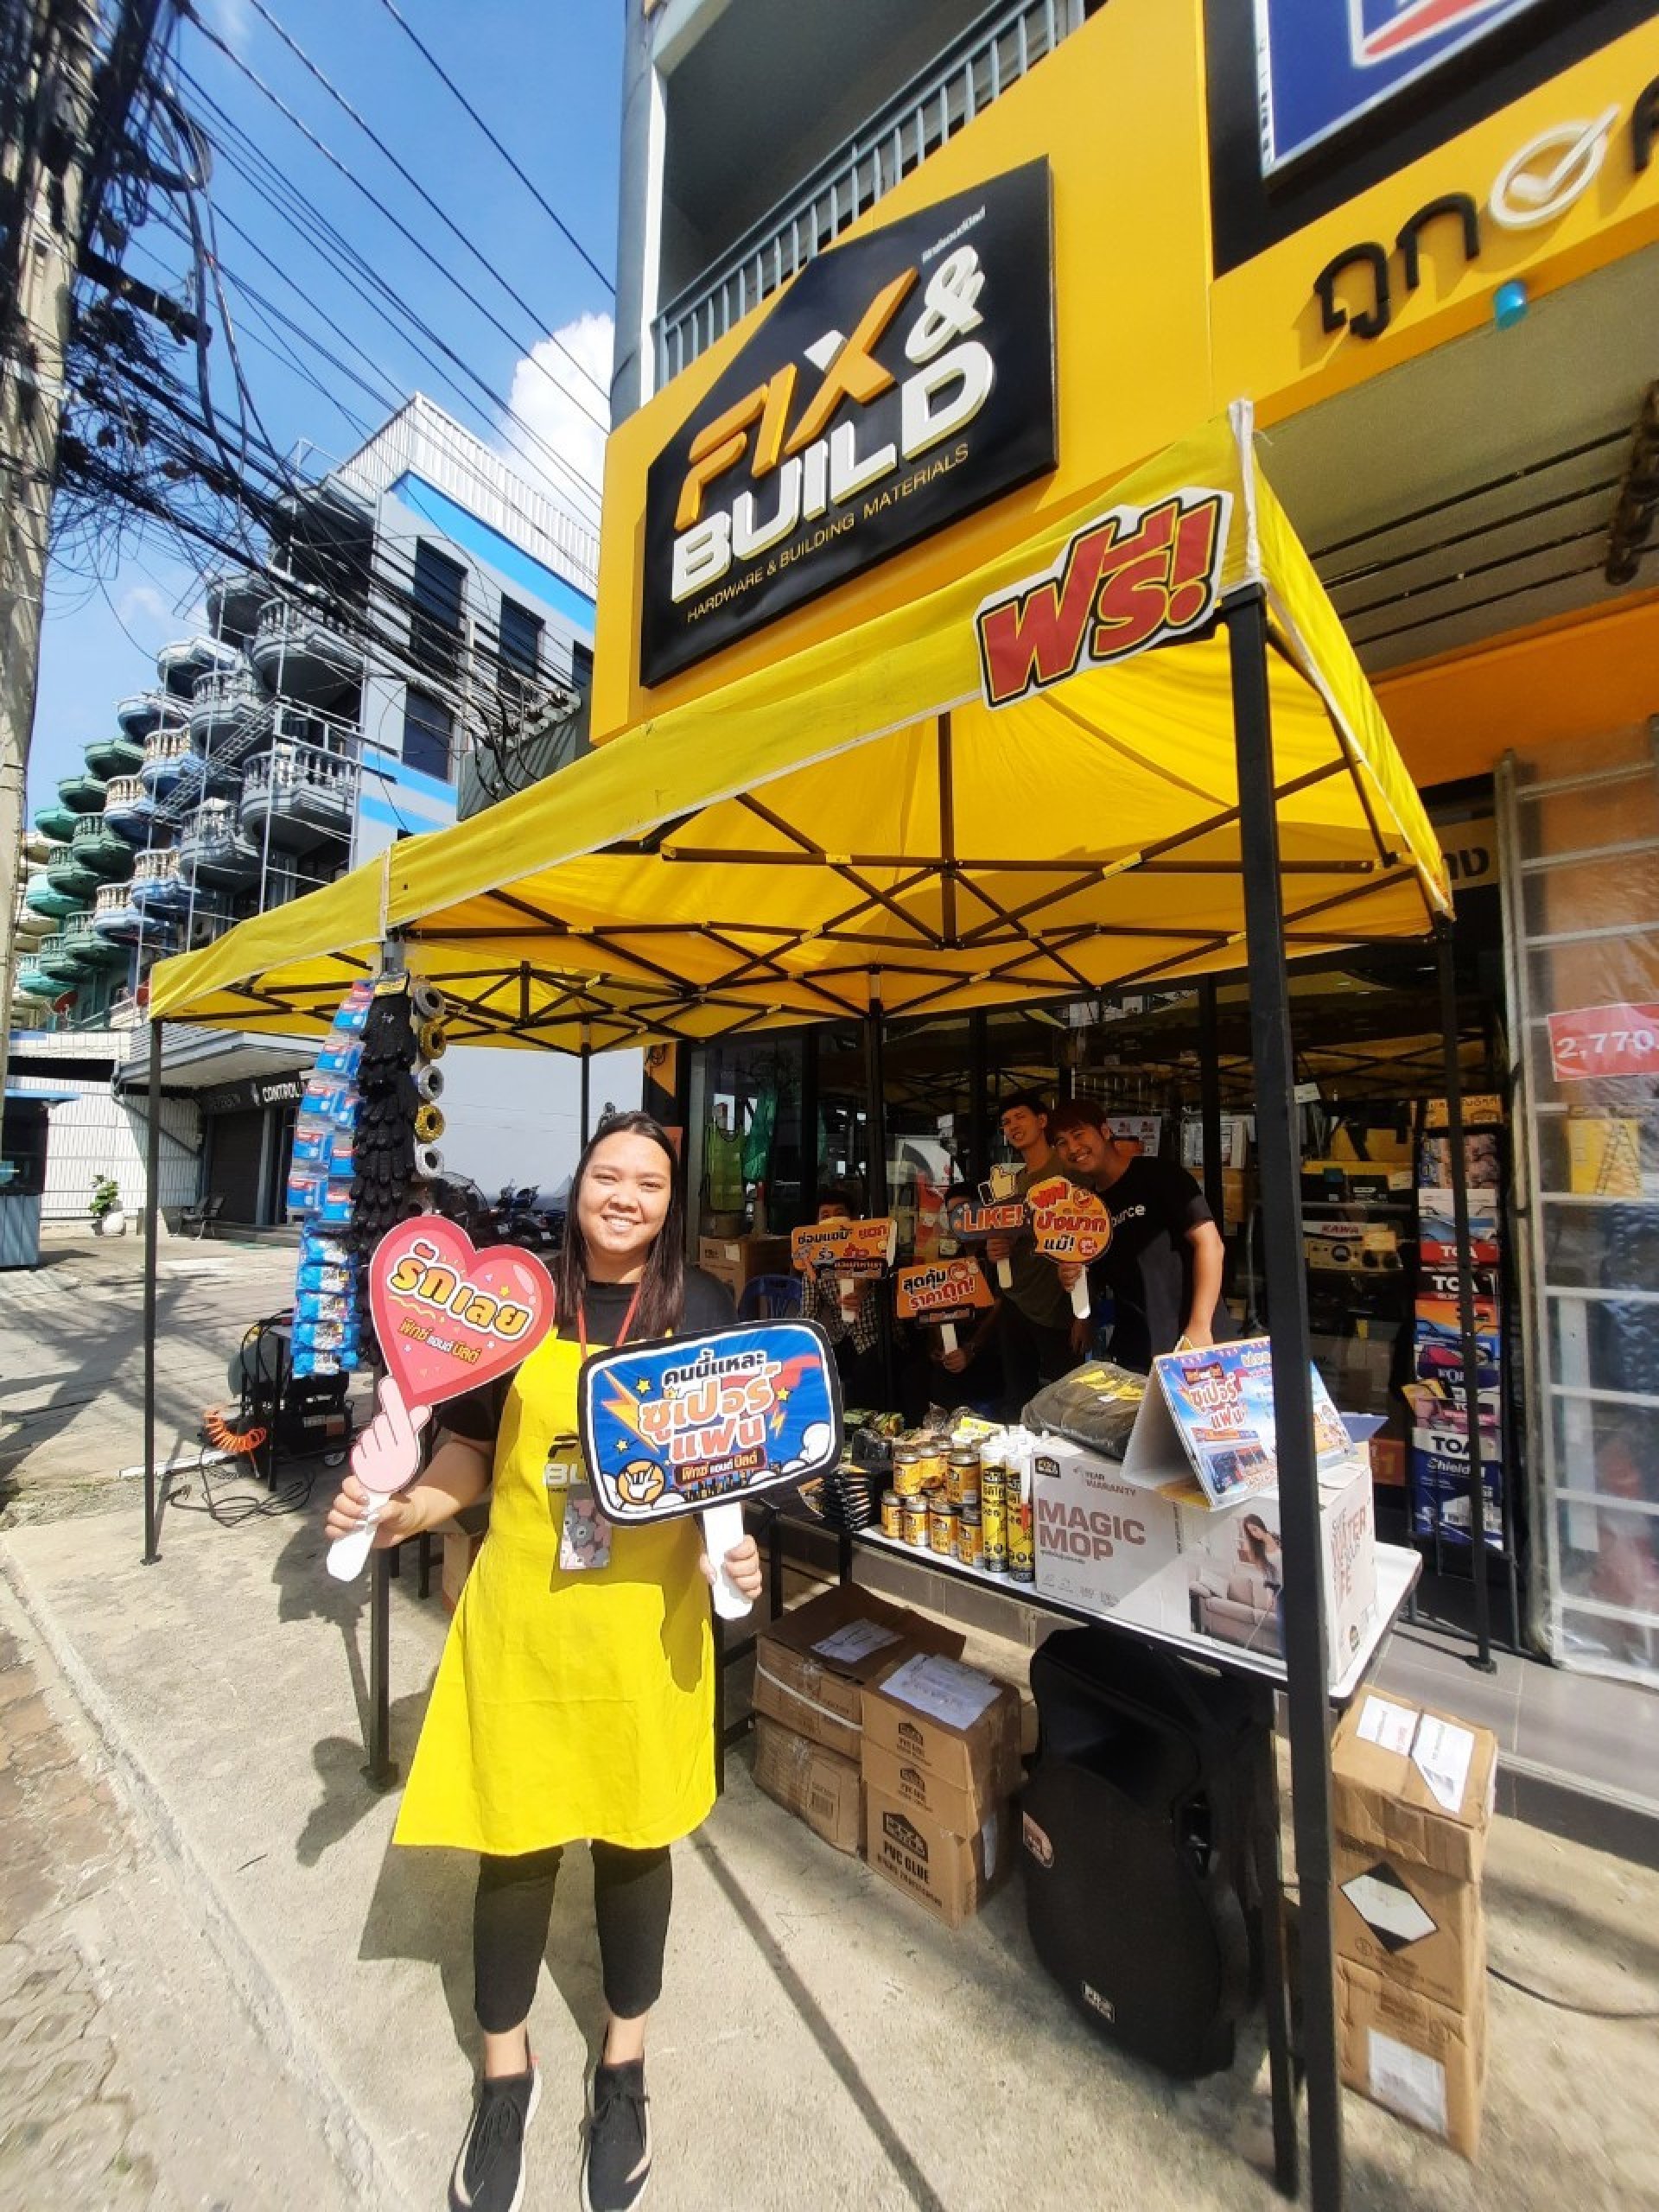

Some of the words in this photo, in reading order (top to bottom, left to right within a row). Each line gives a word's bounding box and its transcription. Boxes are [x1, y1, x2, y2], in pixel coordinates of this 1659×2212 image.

[675, 265, 919, 530] FIX
[906, 245, 985, 364] &
[671, 340, 994, 603] BUILD
[688, 568, 763, 622] HARDWARE
[766, 559, 776, 575] &
[779, 513, 855, 568] BUILDING
[864, 442, 969, 520] MATERIALS
[978, 496, 1221, 706] ฟรี!
[963, 1205, 1023, 1232] LIKE!
[389, 1241, 531, 1337] รักเลย
[671, 1415, 764, 1463] แฟน
[1038, 1497, 1147, 1546] MAGIC
[1039, 1523, 1114, 1561] MOP
